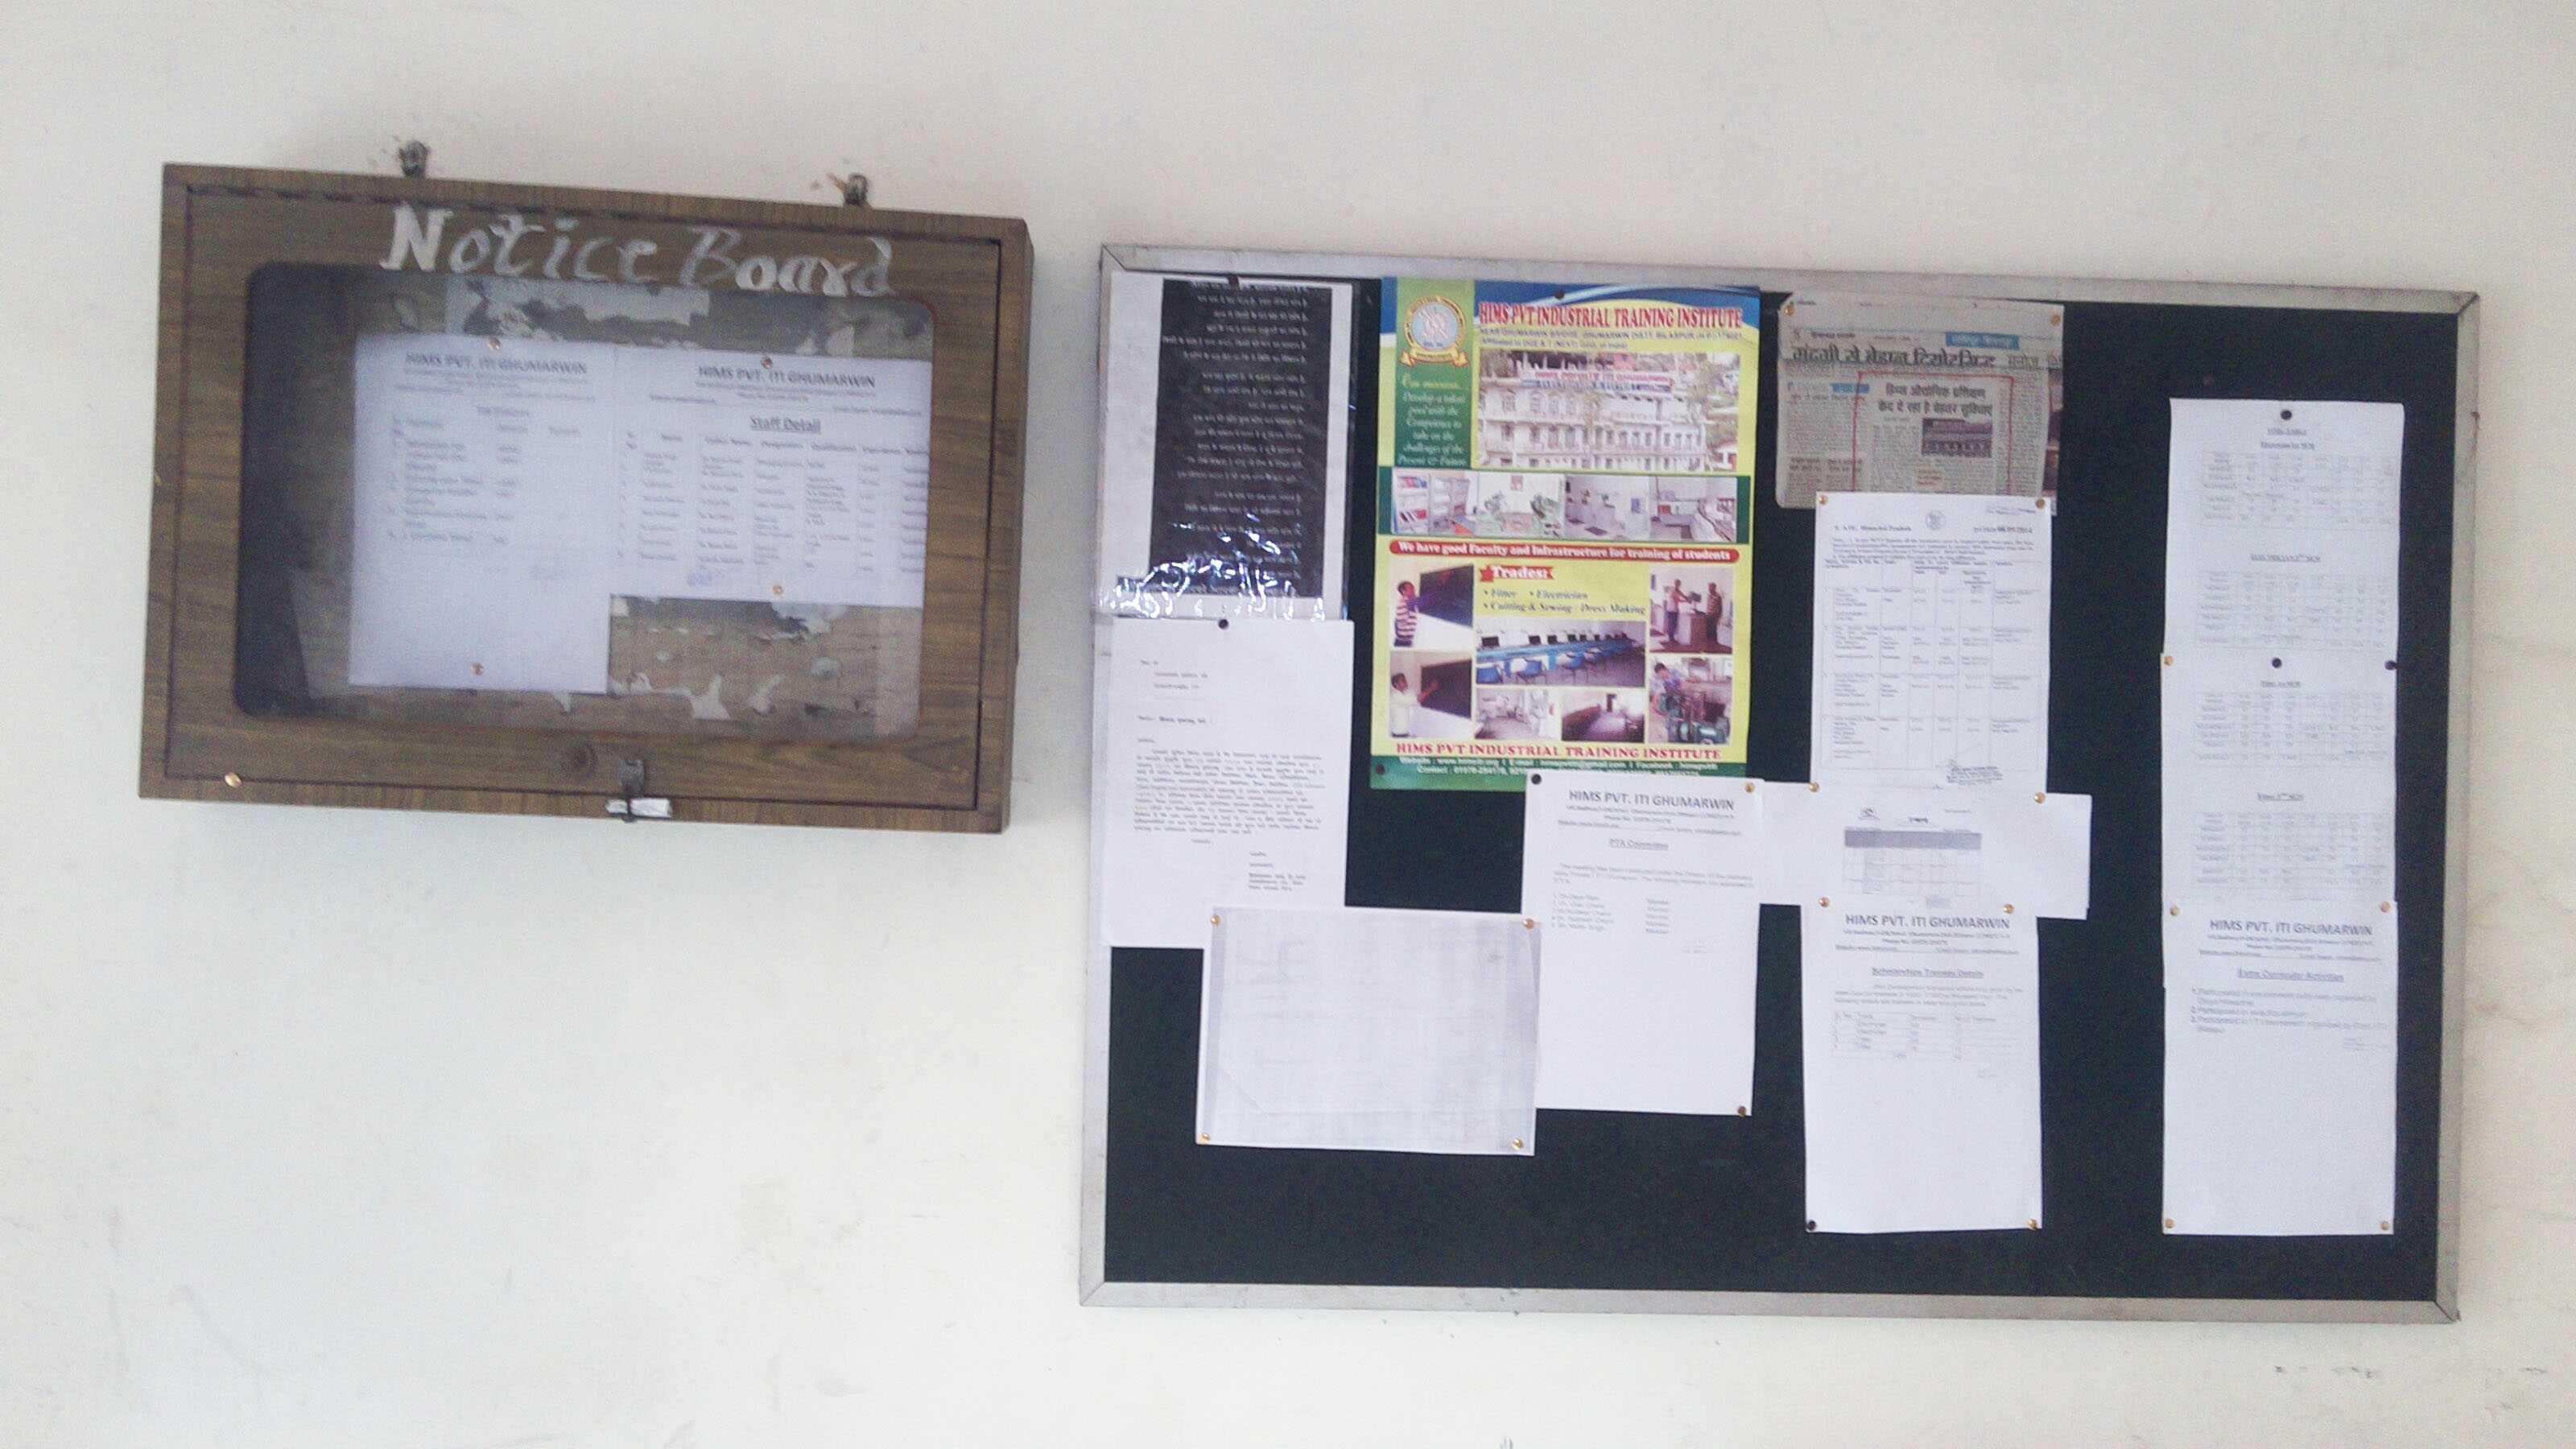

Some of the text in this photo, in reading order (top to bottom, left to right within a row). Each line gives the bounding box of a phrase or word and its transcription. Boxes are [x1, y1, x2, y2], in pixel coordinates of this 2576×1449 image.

[380, 203, 894, 296] Notice Board
[1480, 303, 1742, 328] HIMS PVT INDUSTRIAL TRAINING INSTITUTE
[698, 365, 733, 378] HIMS
[788, 370, 875, 388] GHUMARWIN
[750, 415, 780, 431] Staff
[1397, 541, 1731, 561] We have good Faculty and Infrastructure for training of students
[1492, 565, 1548, 579] Trades:
[1491, 588, 1516, 598] Fitter
[1536, 590, 1588, 600] Electrician
[1490, 602, 1525, 613] Cutting
[1580, 604, 1645, 616] Dress Making
[1397, 743, 1721, 759] HIMS PVT INDUSTRIAL TRAINING INSTITUTE
[1569, 790, 1734, 811] HIMS PVT. ITI GHUMARWIN
[1845, 914, 2010, 929] HIMS PVT. ITI GHUMARWIN
[2210, 919, 2373, 935] HIMS PVT. ITI GHUMARWIN
